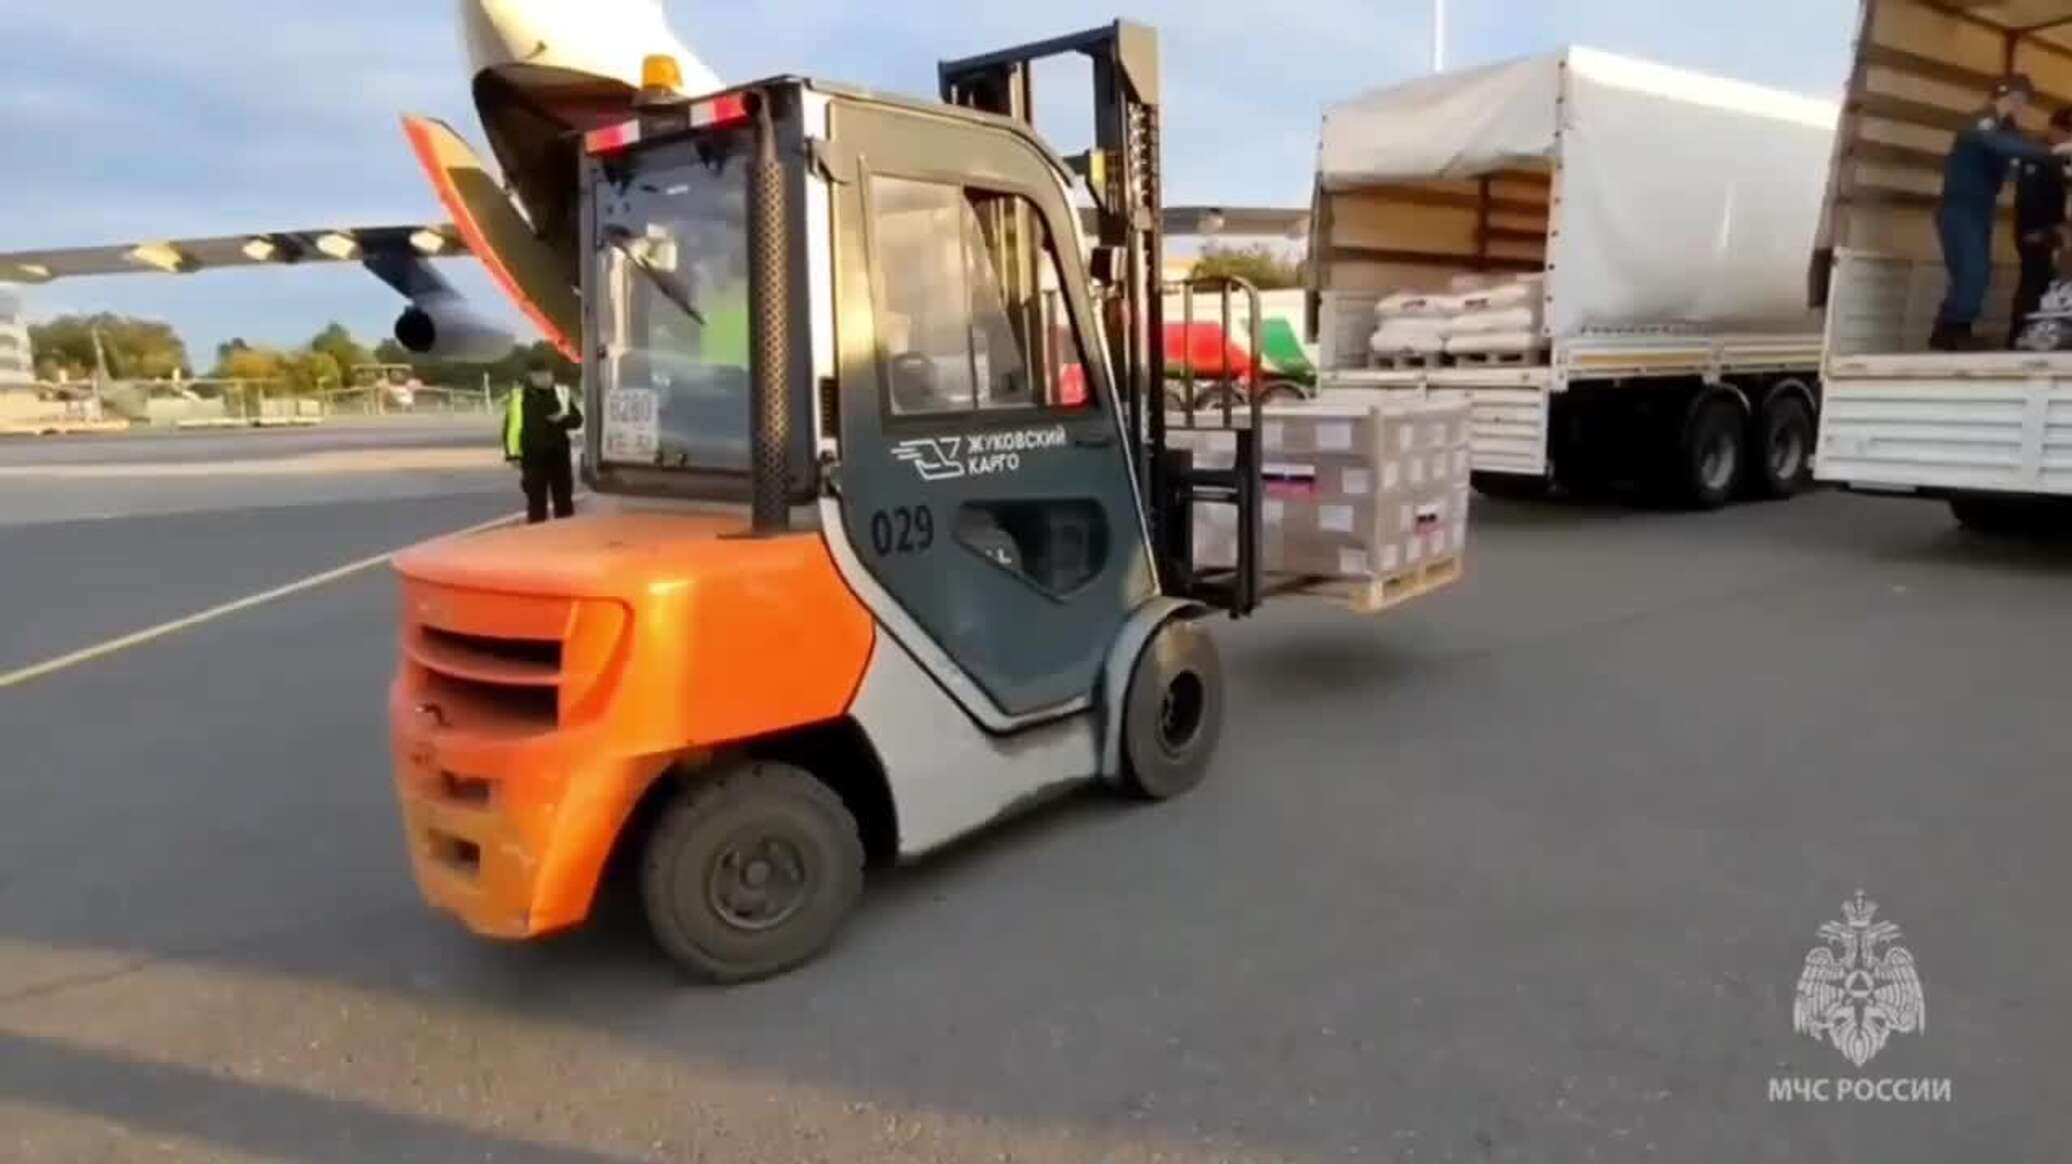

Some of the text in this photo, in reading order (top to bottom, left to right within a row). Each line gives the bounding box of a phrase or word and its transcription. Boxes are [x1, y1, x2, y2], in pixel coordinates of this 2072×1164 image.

[967, 424, 1066, 454] ЖУКОВСКИЙ
[967, 452, 1020, 475] КАРГО
[871, 504, 934, 557] 029
